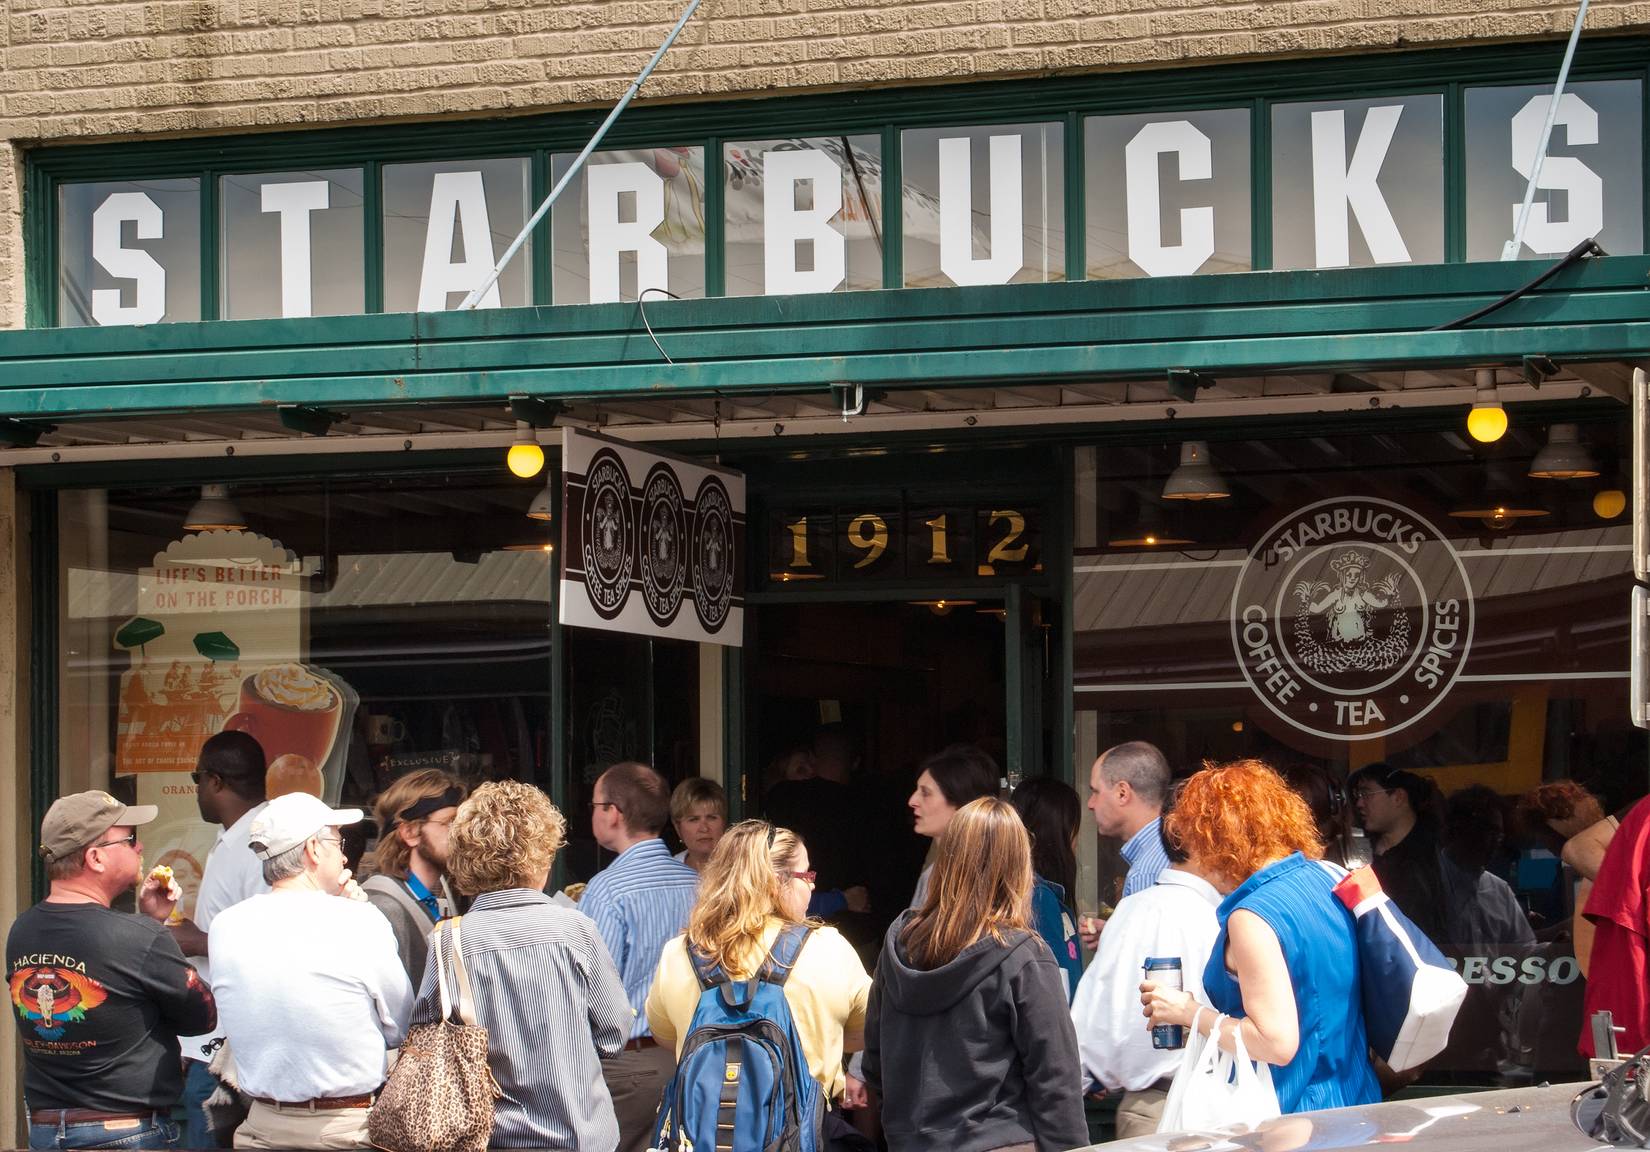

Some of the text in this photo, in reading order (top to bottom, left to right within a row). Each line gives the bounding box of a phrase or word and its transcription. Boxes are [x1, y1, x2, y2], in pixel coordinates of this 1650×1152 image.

[92, 93, 1604, 326] STARBUCKS
[592, 466, 625, 500] STARBUCKS
[650, 479, 679, 512] STARBUCKS
[701, 491, 729, 523] STARBUCKS
[787, 510, 1029, 569] 1912
[1273, 508, 1426, 562] STARBUCKS
[156, 564, 281, 584] LIFE'S BETTER
[156, 591, 178, 608] ON
[186, 590, 217, 607] THE
[585, 544, 632, 604] COFFEE TEA SPICES
[643, 555, 685, 613] COFFEE TEA SPICES
[694, 565, 708, 614] COFFEE
[709, 605, 718, 620] TEA
[1243, 598, 1460, 726] COFFEE TEA SPICES
[13, 953, 87, 974] HACIENDA
